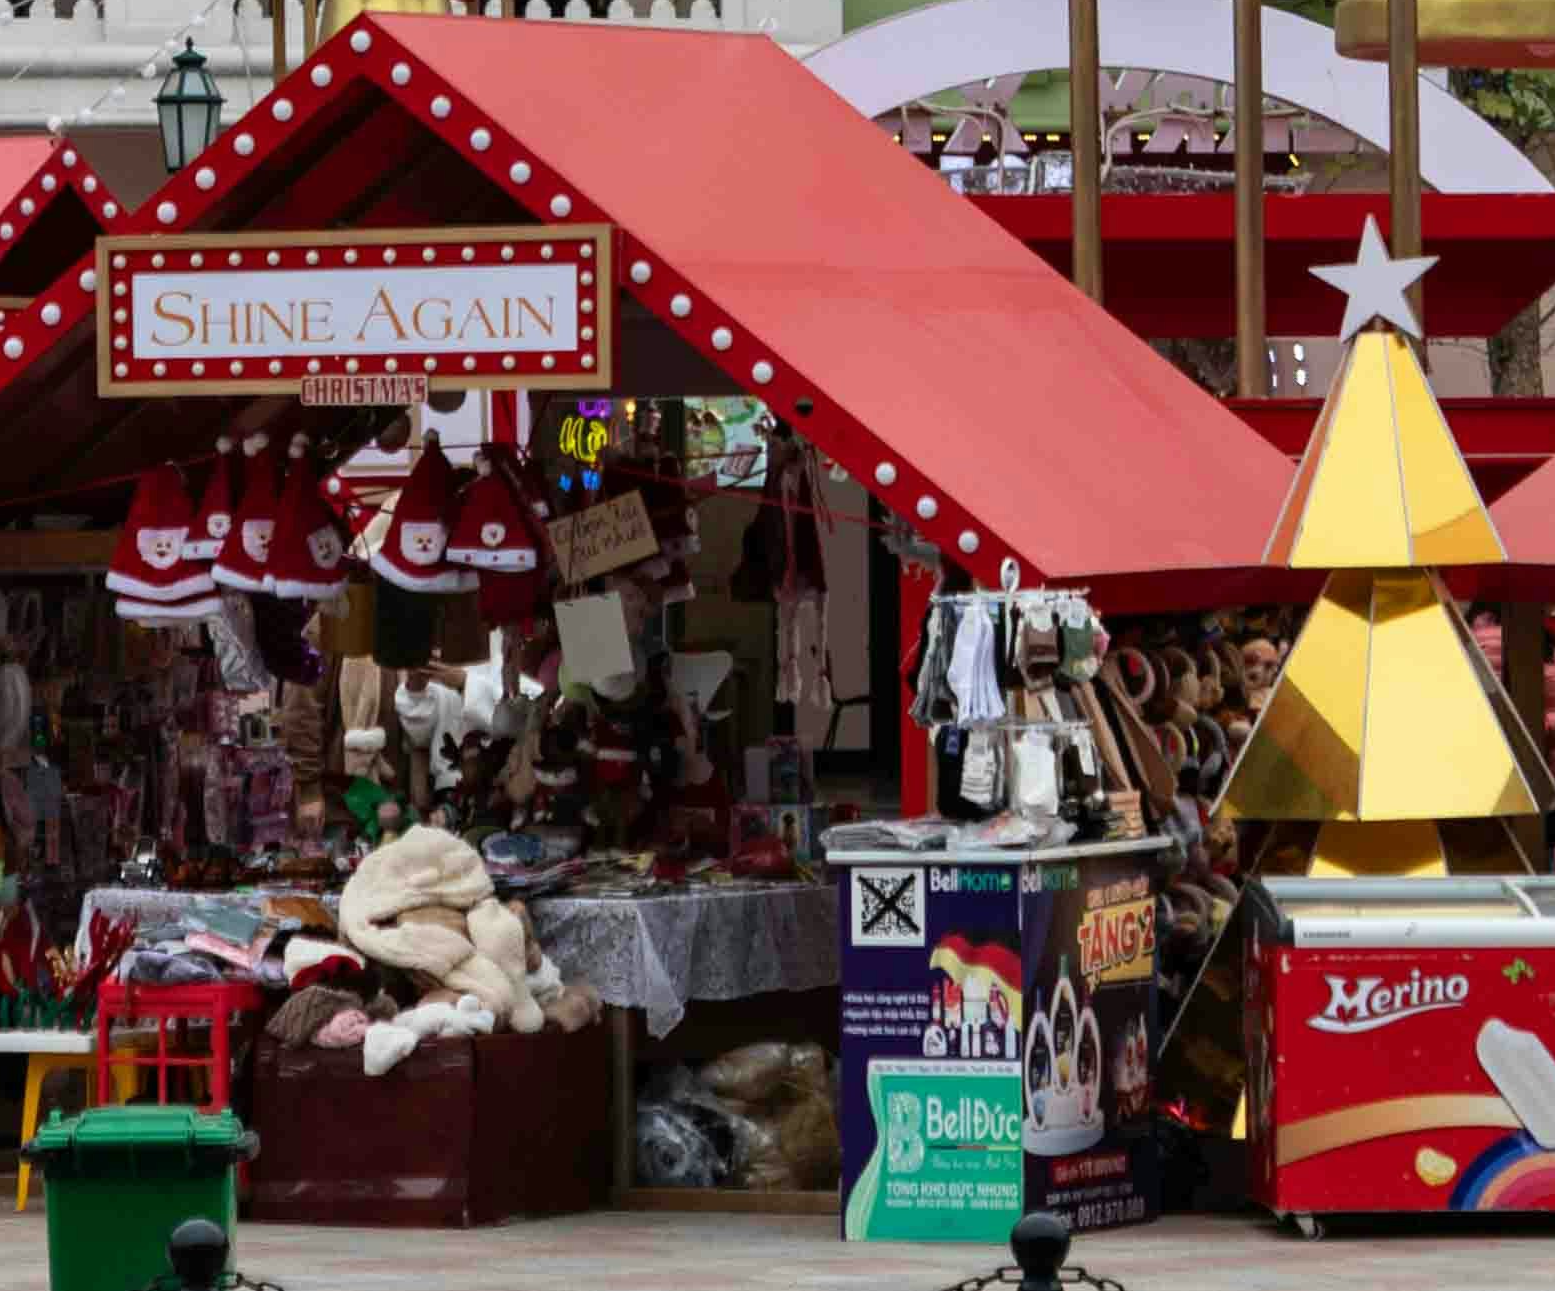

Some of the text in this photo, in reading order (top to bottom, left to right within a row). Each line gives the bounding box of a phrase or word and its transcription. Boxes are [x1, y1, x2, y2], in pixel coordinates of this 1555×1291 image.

[148, 285, 555, 348] SHINE AGAIN
[301, 376, 428, 404] CHRISTMAS
[1140, 904, 1156, 956] 2
[1324, 968, 1471, 1022] Merino
